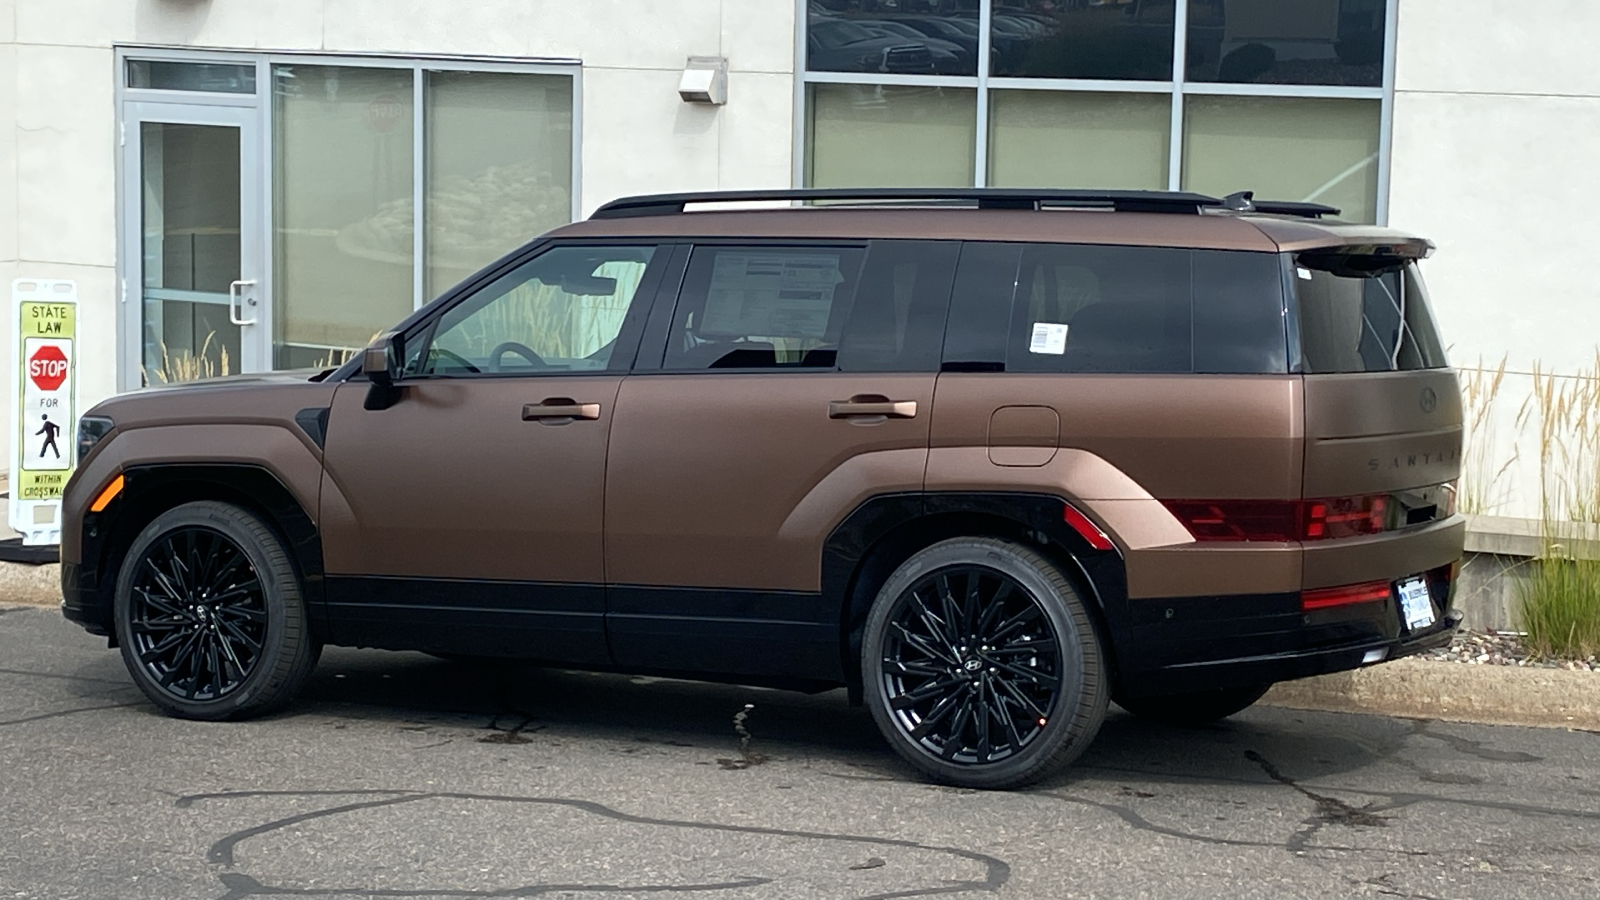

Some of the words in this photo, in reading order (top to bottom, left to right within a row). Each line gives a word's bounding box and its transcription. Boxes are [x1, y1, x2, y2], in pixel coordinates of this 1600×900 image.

[32, 306, 66, 318] STATE
[37, 322, 62, 333] LAW
[31, 359, 67, 377] STOP
[40, 398, 58, 407] FOR
[34, 474, 62, 484] WITHIN
[25, 486, 64, 498] CROSSWAL
